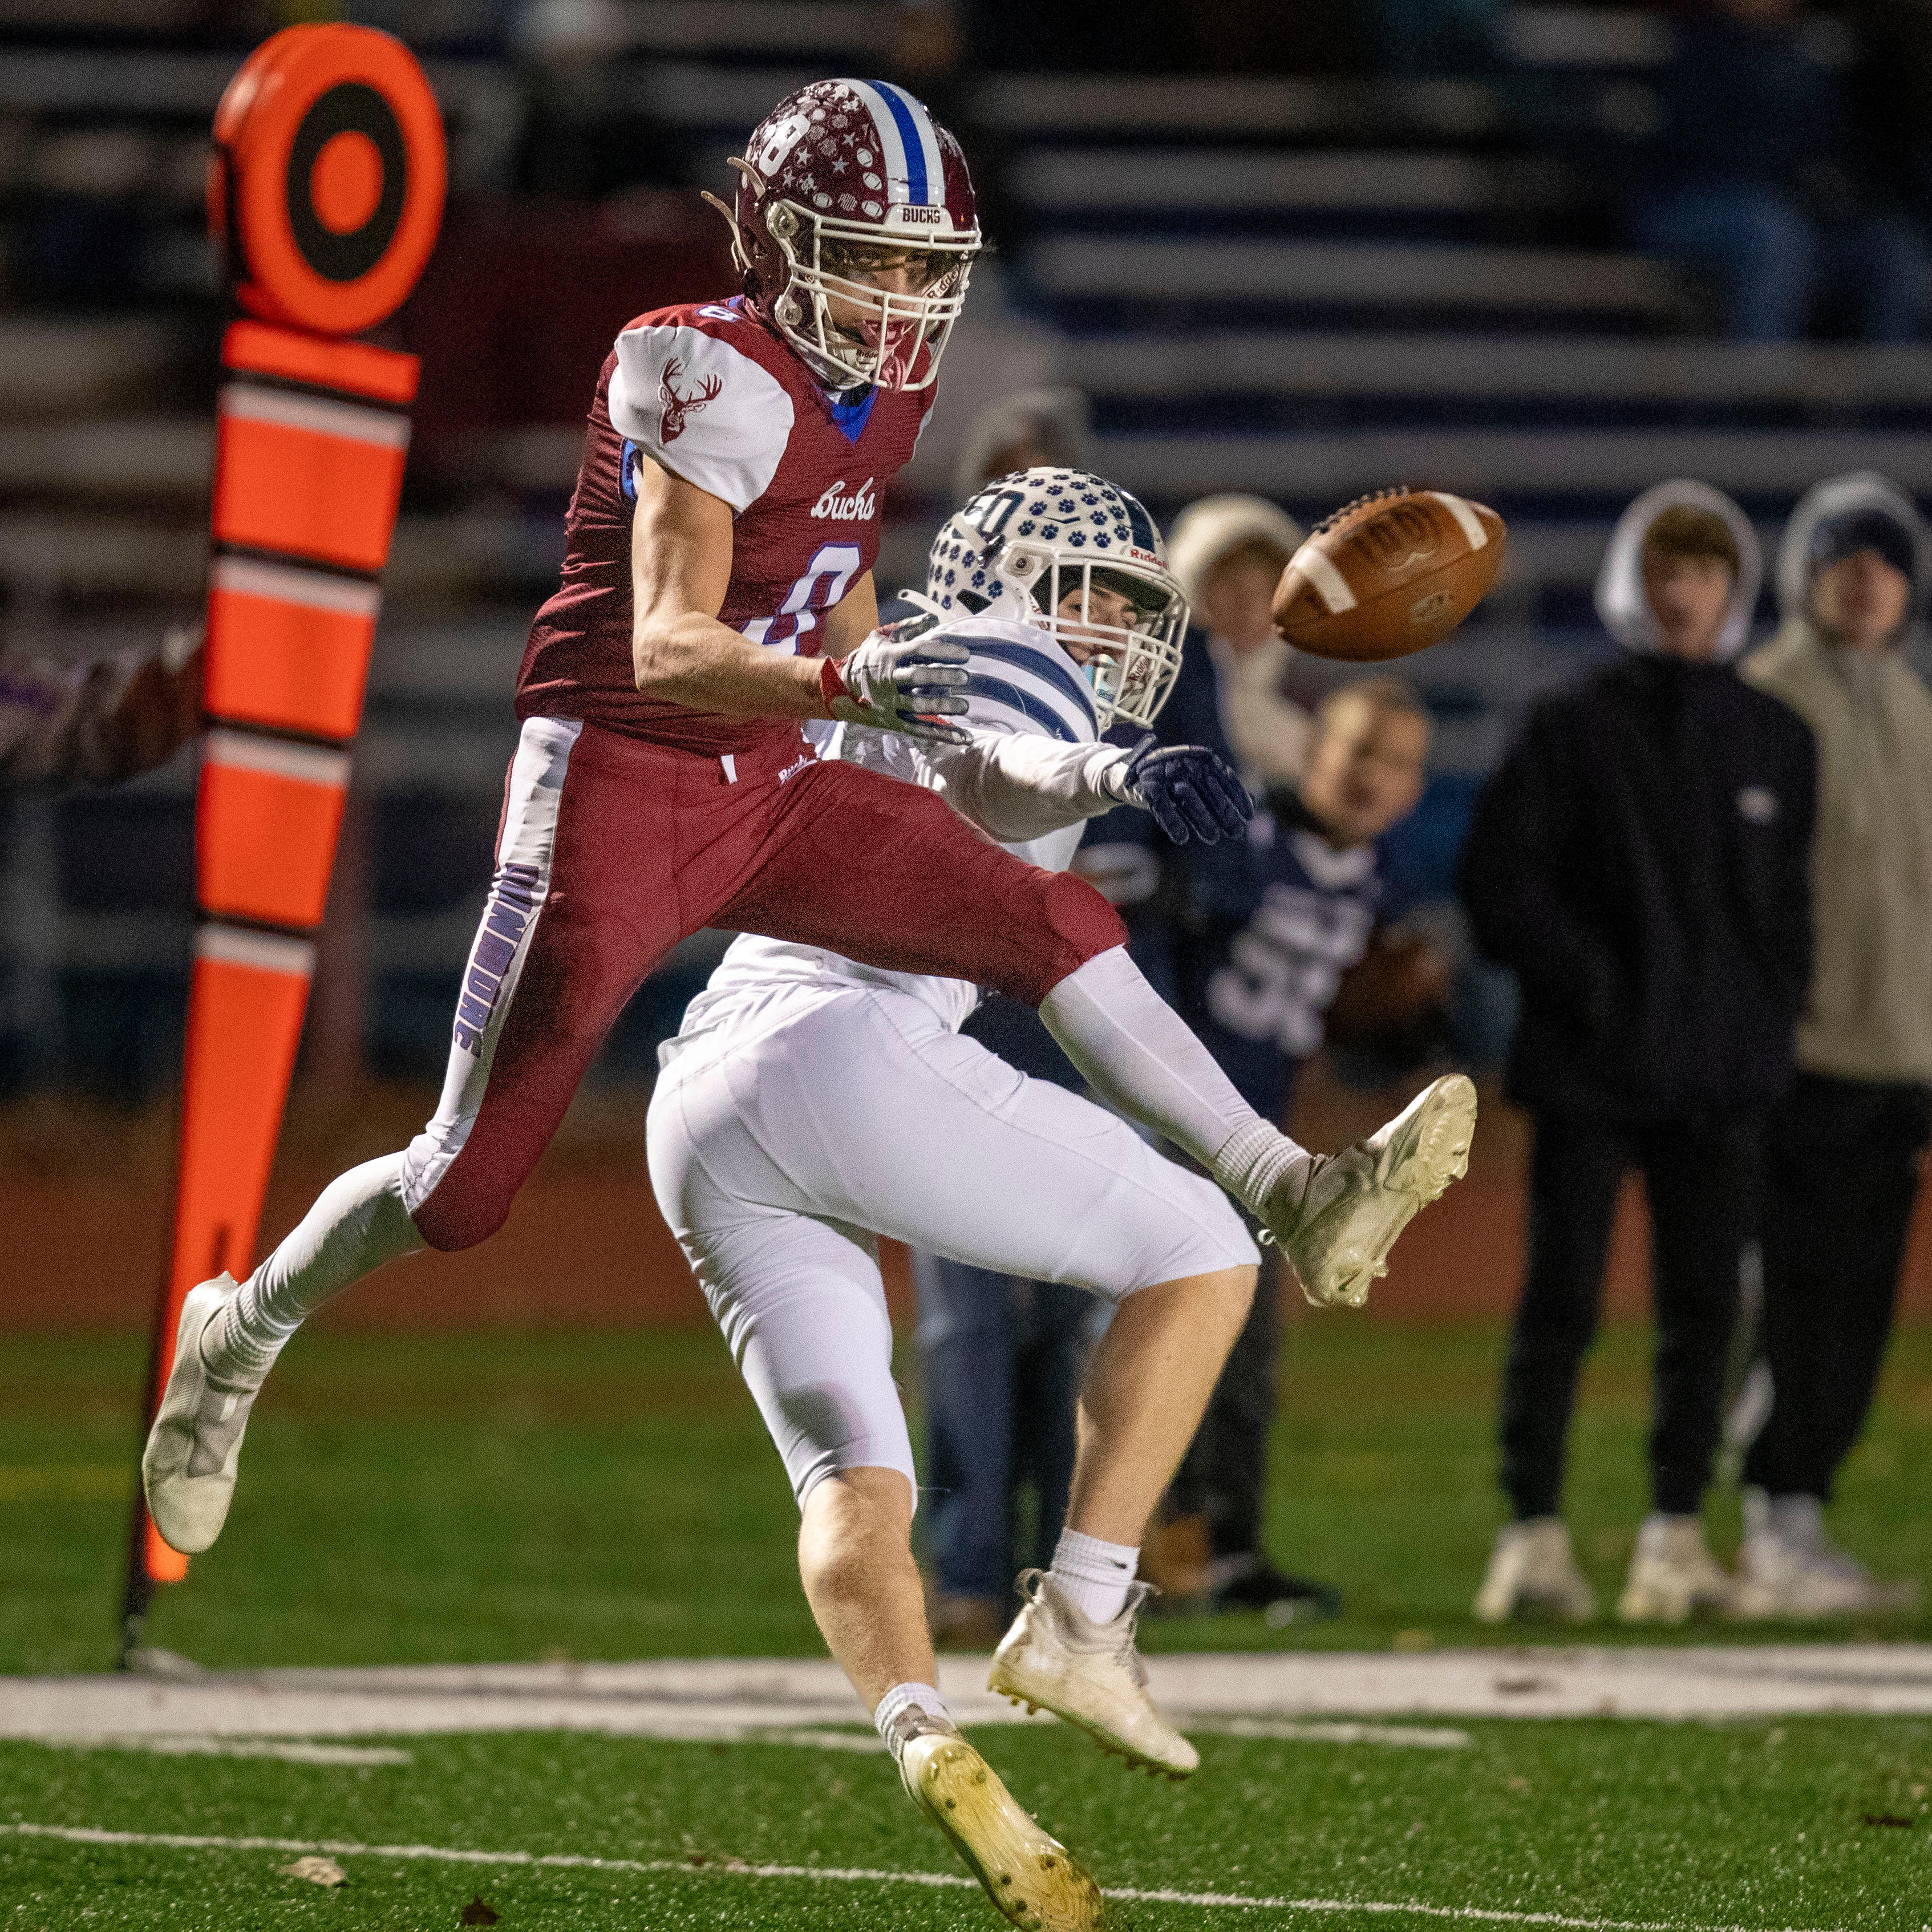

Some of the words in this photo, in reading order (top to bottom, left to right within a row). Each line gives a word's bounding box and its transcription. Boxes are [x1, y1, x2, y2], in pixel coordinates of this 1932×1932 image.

[759, 114, 811, 177] 8
[902, 208, 941, 224] BUCKS
[811, 476, 875, 520] Bucks
